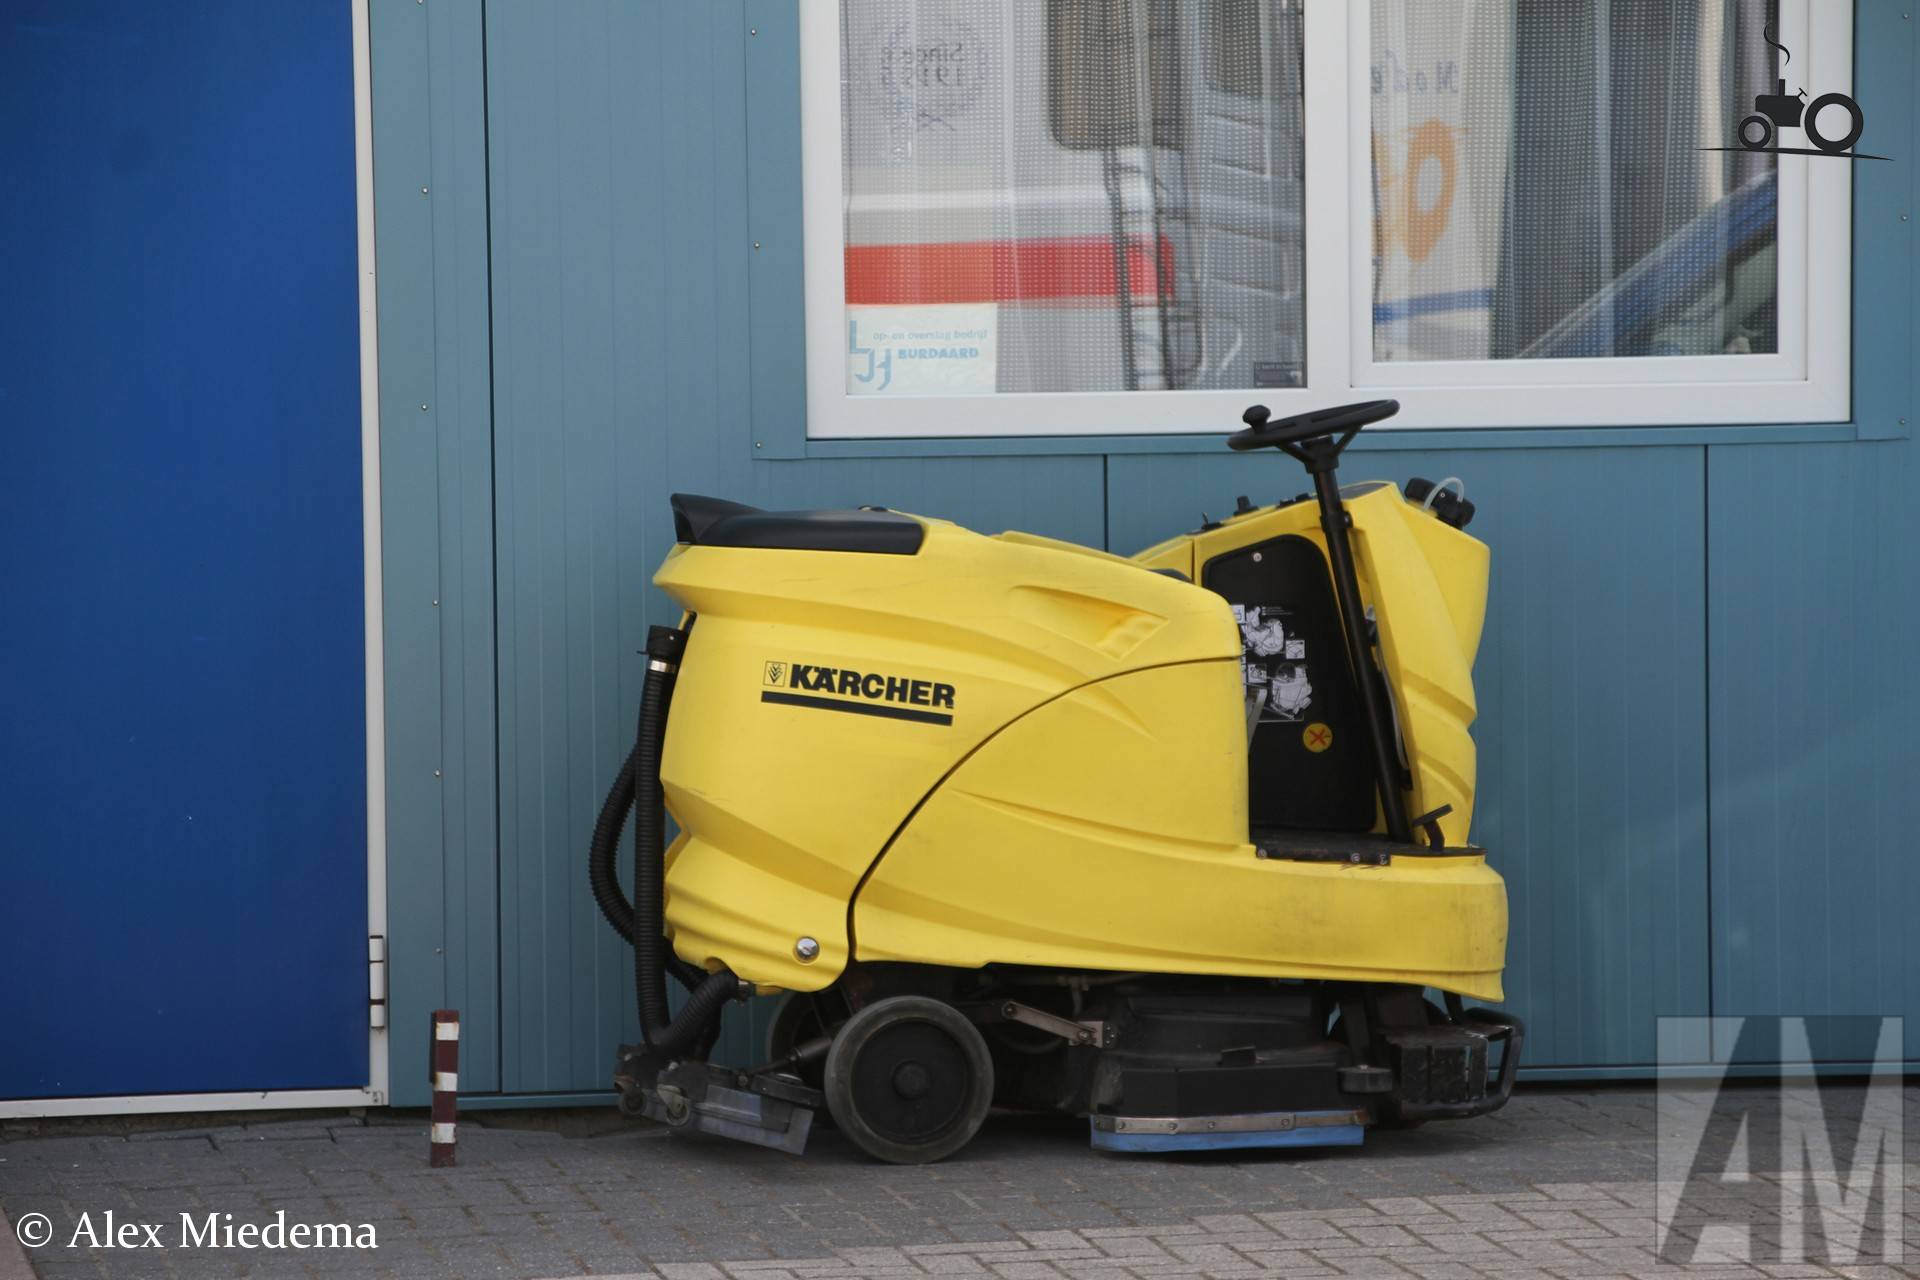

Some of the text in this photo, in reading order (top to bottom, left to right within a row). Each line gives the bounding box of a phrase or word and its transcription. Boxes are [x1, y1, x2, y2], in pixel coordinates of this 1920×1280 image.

[892, 332, 905, 341] en
[908, 330, 952, 341] overslag
[954, 328, 988, 341] bedrijf
[898, 347, 979, 359] BURDAARD
[789, 664, 956, 709] KÄRCHER
